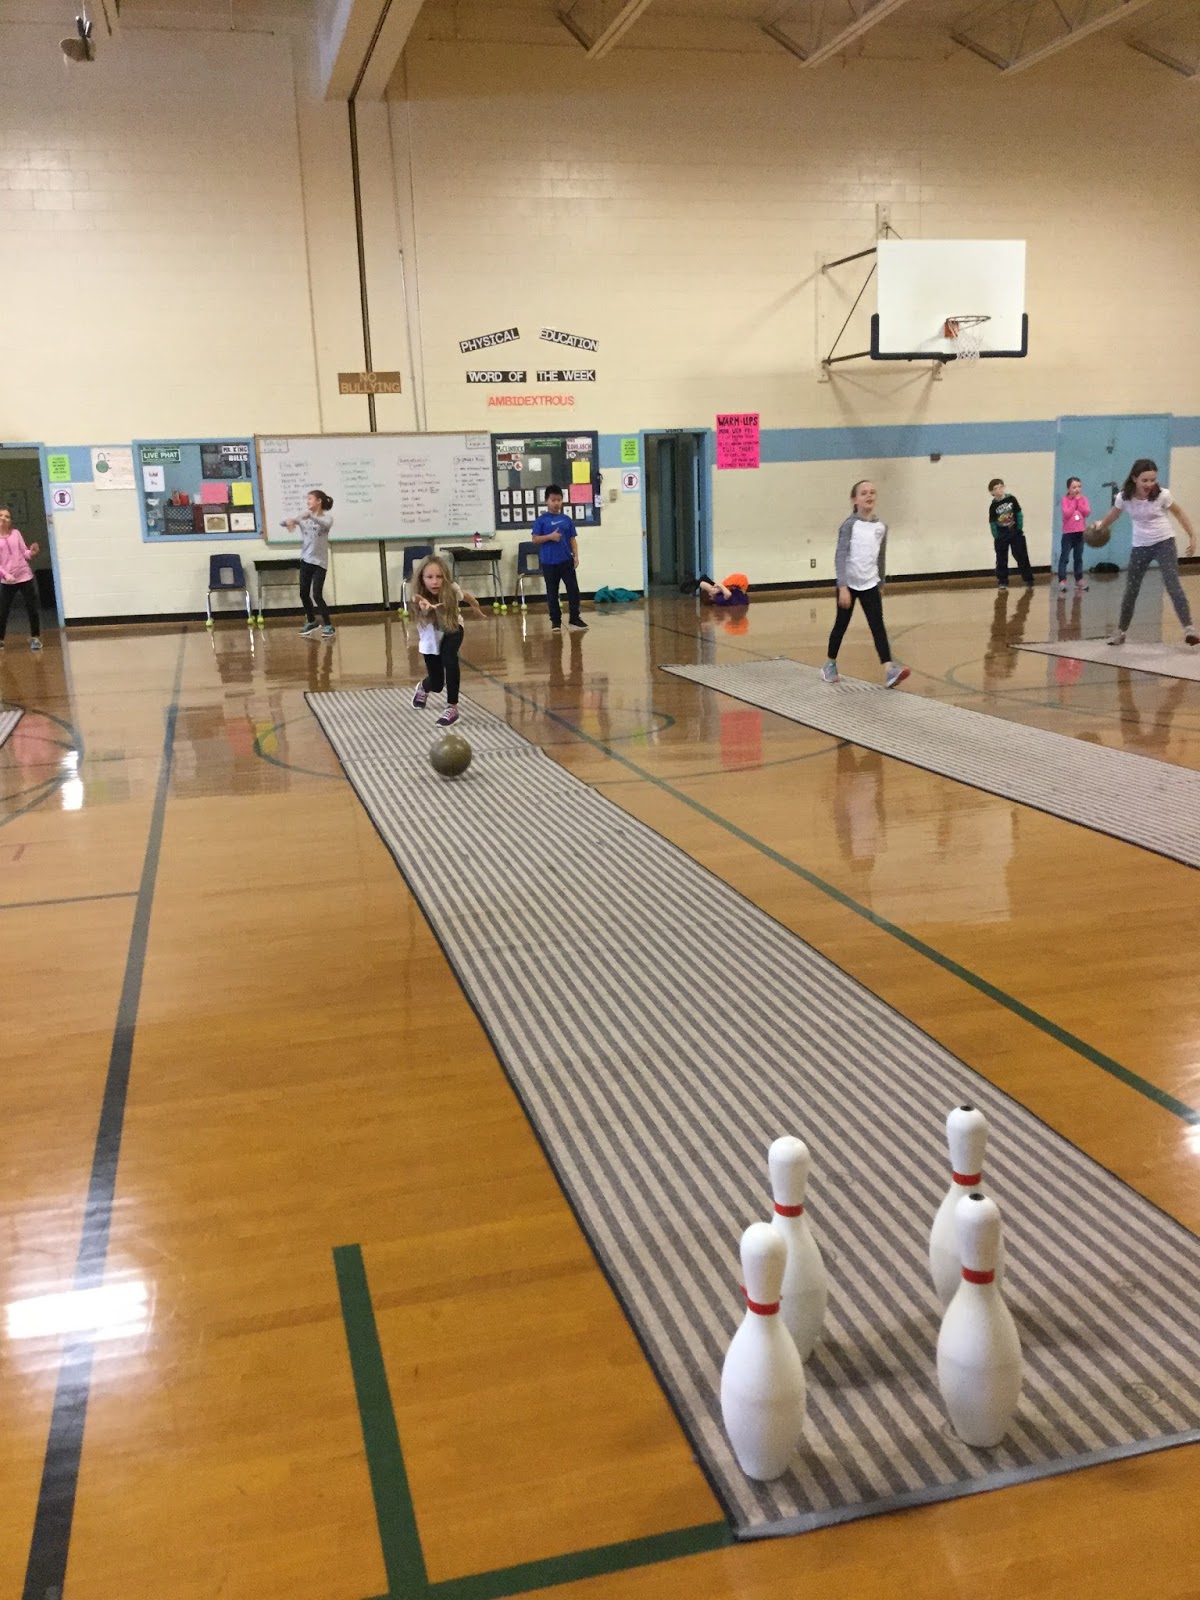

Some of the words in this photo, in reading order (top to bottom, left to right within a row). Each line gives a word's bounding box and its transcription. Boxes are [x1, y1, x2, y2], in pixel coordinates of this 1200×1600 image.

[460, 328, 520, 353] PHYSICAL
[540, 328, 598, 352] EDUCATION
[360, 372, 377, 382] NO
[468, 371, 503, 382] WORD
[508, 371, 524, 382] OF
[537, 371, 559, 381] THE
[563, 370, 595, 381] WEEK
[340, 382, 400, 393] BULLYING
[488, 395, 575, 406] AMBIDEXTROUS
[160, 451, 178, 459] PHAT
